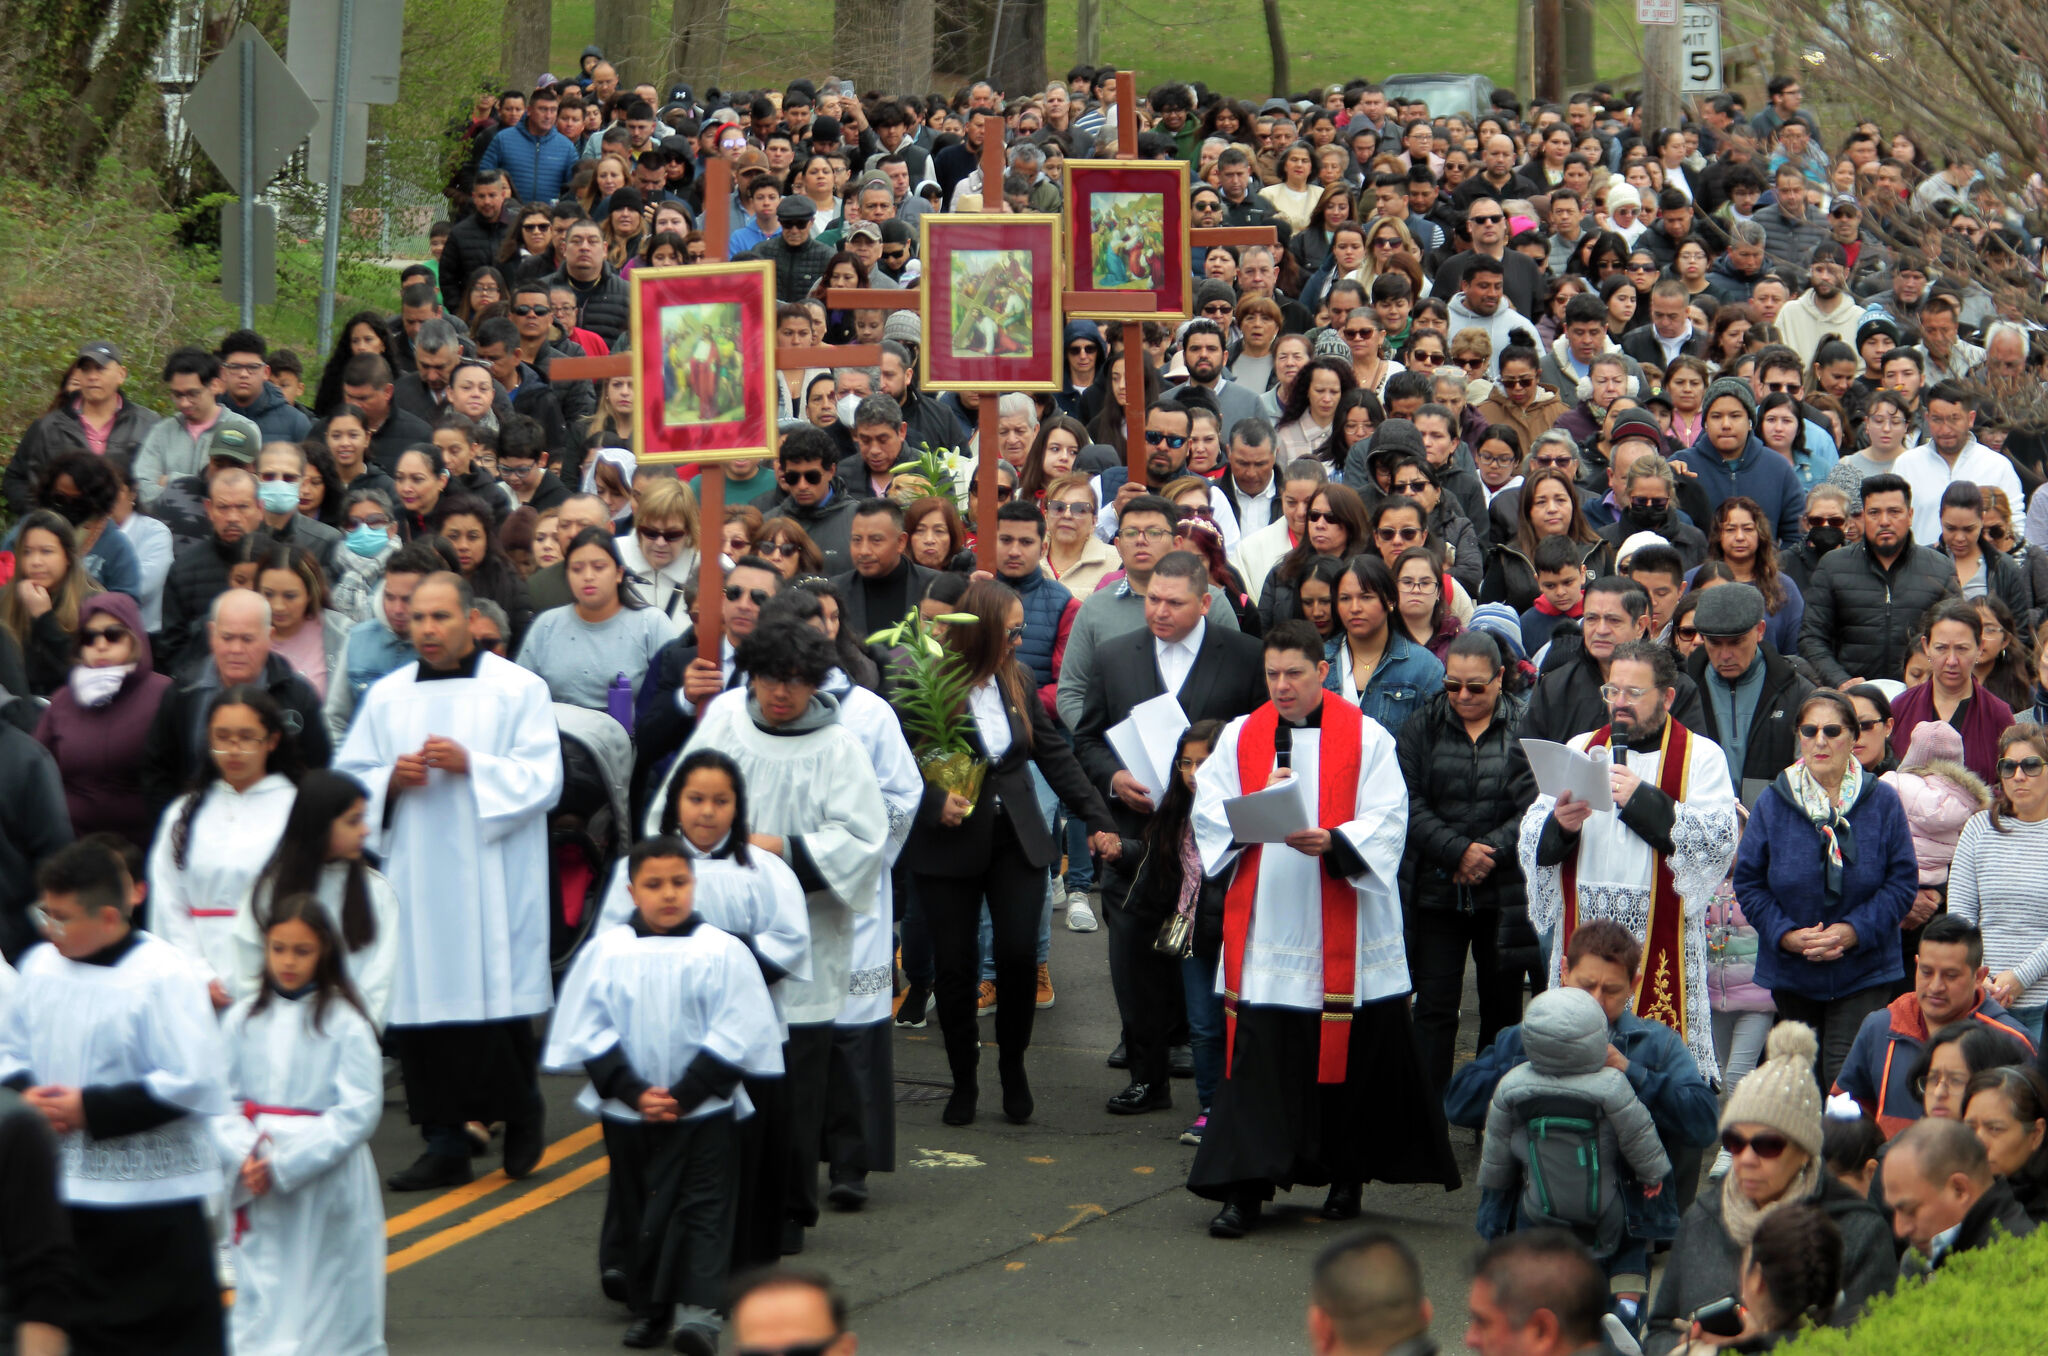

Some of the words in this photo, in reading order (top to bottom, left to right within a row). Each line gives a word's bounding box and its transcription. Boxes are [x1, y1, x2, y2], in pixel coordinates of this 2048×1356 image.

[1682, 15, 1713, 28] EED
[1682, 33, 1707, 46] MIT
[1690, 51, 1712, 81] 5
